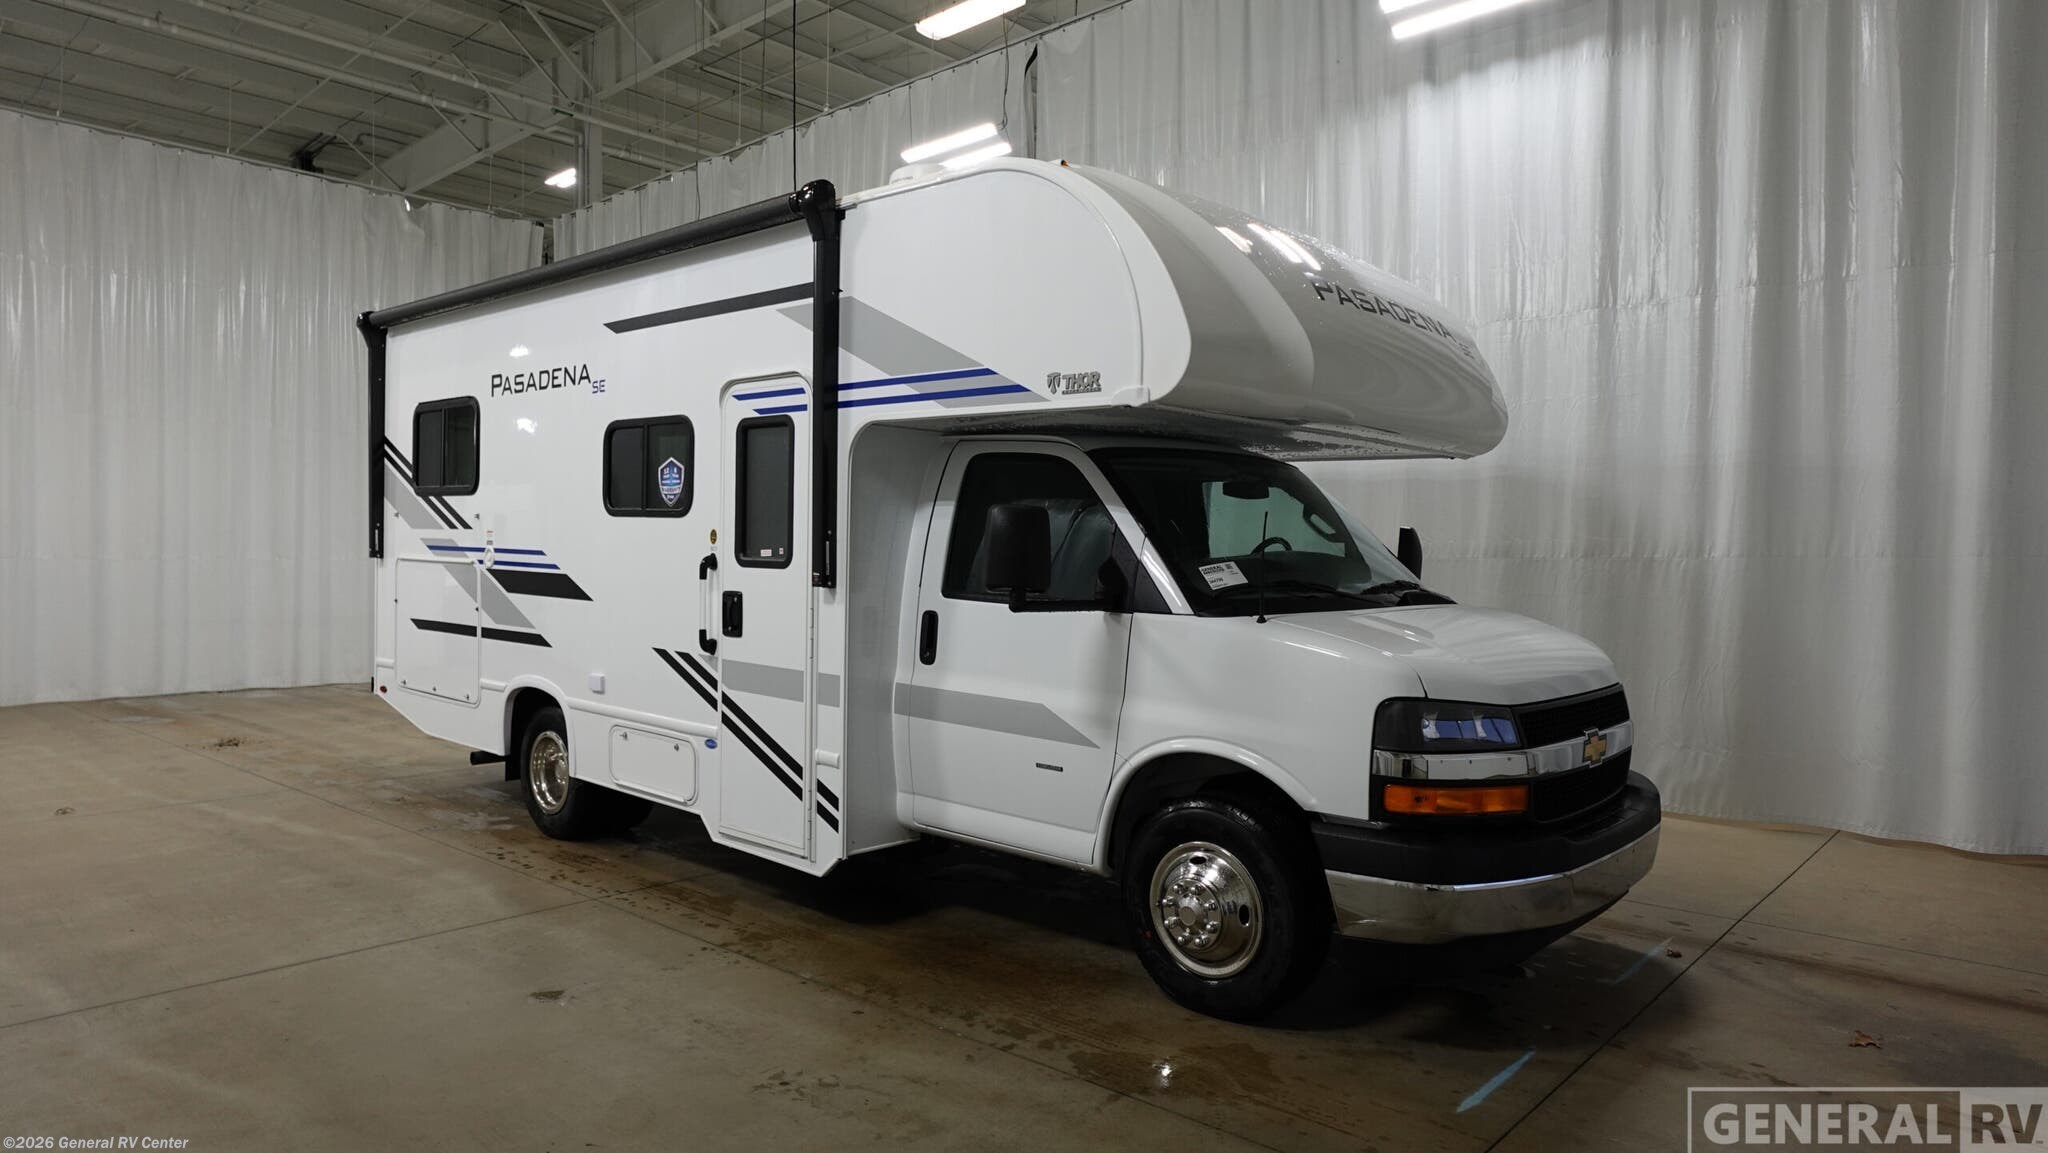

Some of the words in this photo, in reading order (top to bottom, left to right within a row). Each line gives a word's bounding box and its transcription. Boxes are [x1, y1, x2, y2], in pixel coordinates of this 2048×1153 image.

[1311, 281, 1457, 344] PASADENA
[491, 363, 592, 398] PASADENA
[592, 379, 606, 394] SE
[1061, 371, 1102, 390] THOR
